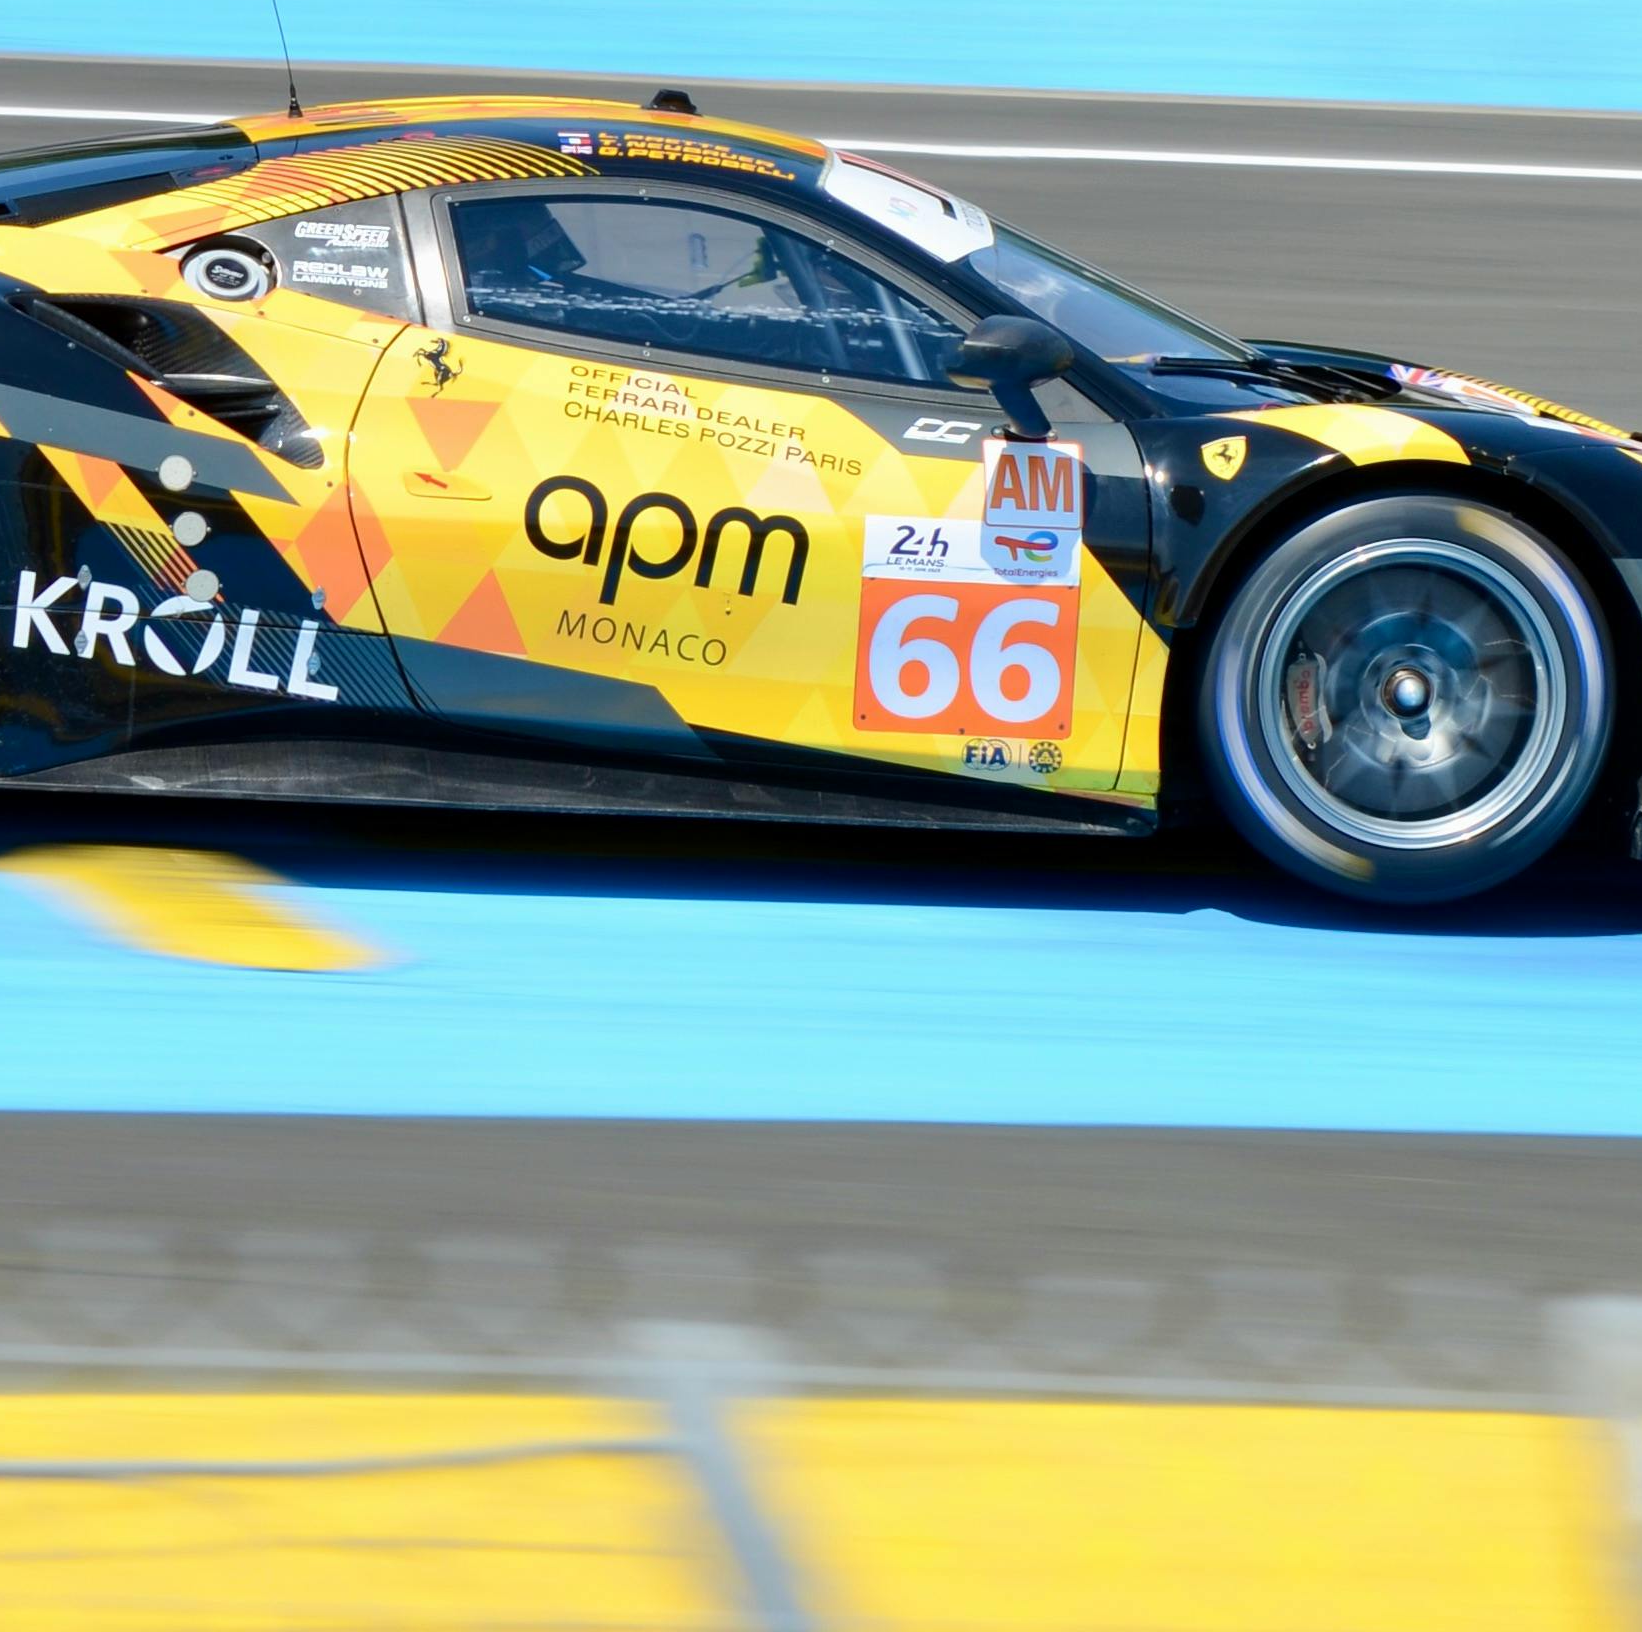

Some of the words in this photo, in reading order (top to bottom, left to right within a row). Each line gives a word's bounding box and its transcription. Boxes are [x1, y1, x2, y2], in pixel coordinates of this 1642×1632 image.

[626, 148, 797, 181] PETROBELLI
[292, 274, 388, 289] LAMINATIONS
[568, 381, 687, 417] FERRARI
[696, 406, 805, 441] DEALER
[570, 365, 698, 399] OFFICIAL
[563, 401, 690, 439] CHARLES
[699, 427, 776, 458] POZZI
[785, 445, 862, 476] PARIS
[989, 454, 1074, 513] AM
[525, 475, 809, 606] apm
[886, 556, 904, 566] LE
[904, 557, 945, 568] MANS
[994, 567, 1059, 579] TotalEnergies
[12, 570, 339, 702] KROLL
[557, 610, 727, 667] MONACO
[868, 593, 1061, 723] 66
